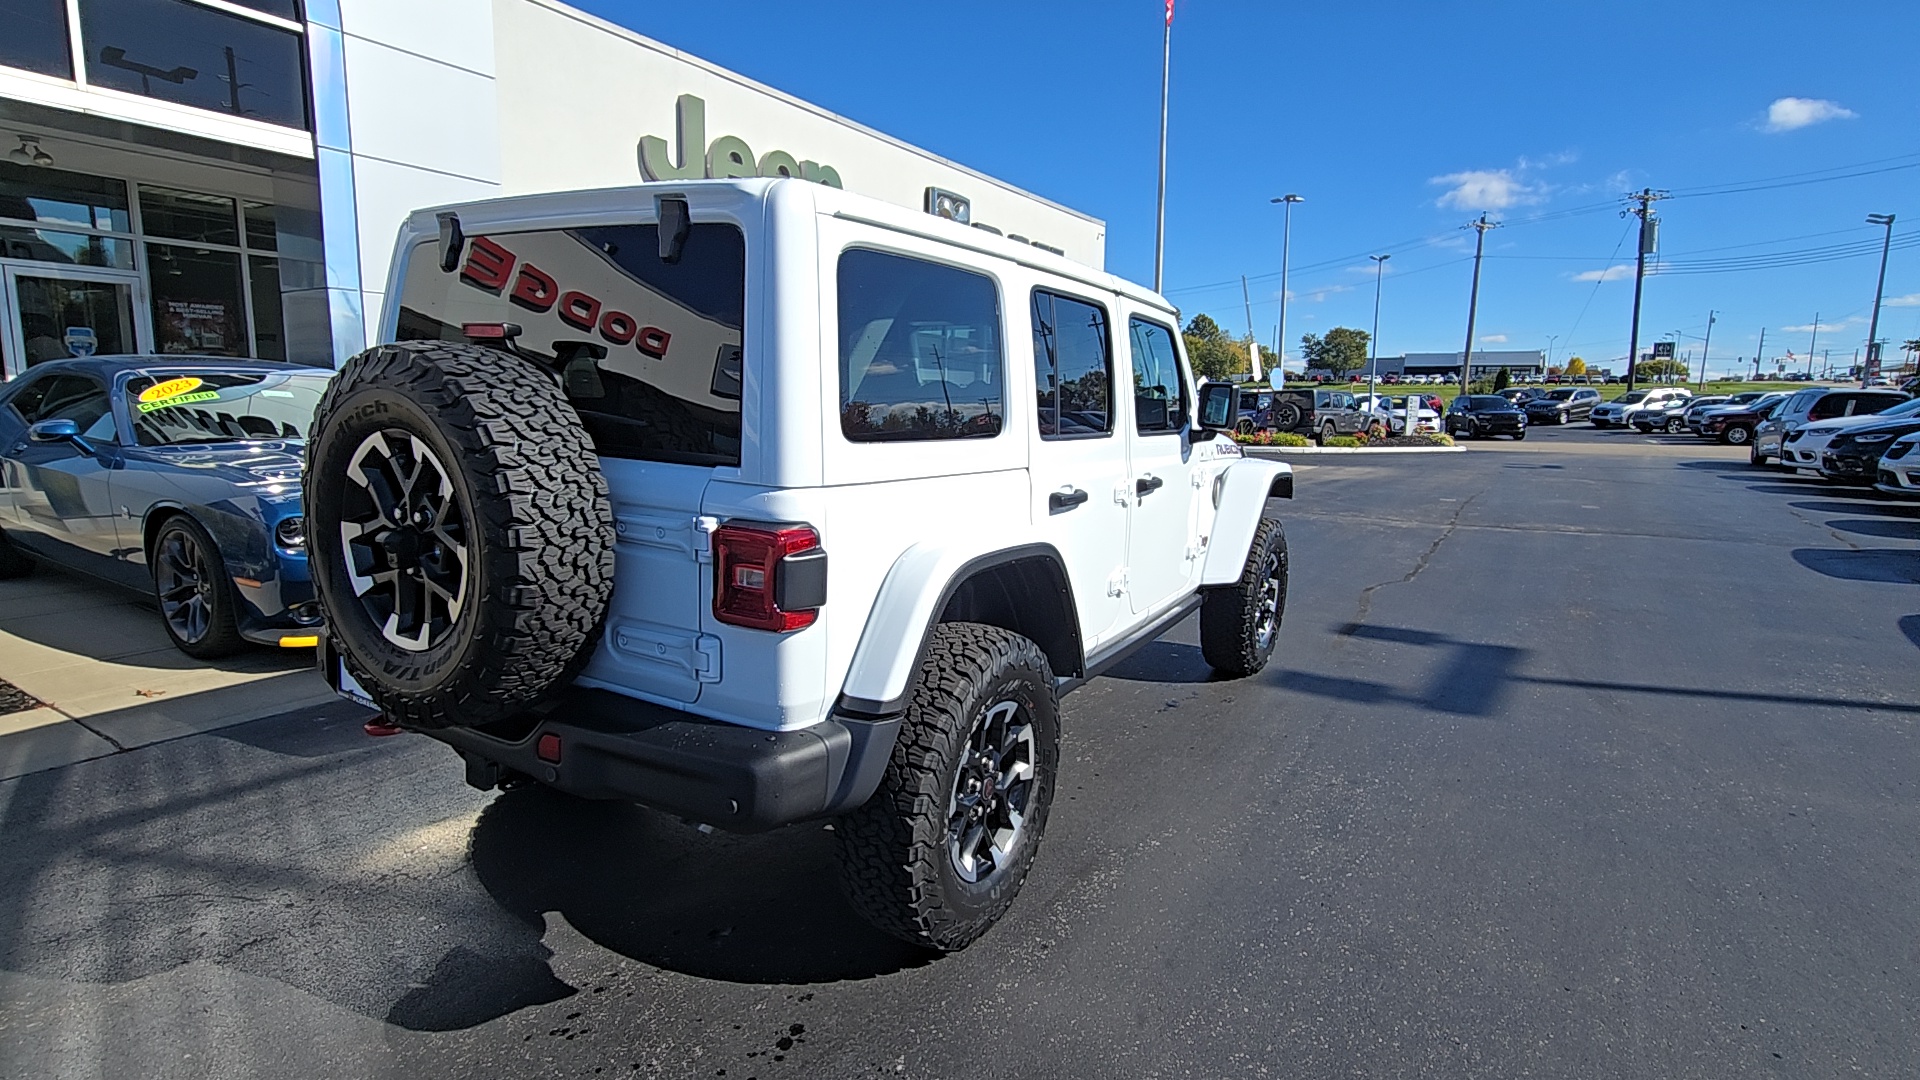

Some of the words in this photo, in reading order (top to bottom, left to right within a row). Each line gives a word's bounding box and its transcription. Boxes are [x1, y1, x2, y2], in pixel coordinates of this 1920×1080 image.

[151, 380, 193, 399] 2023
[141, 392, 215, 411] CERTIFIED
[1216, 444, 1240, 456] RUBIC
